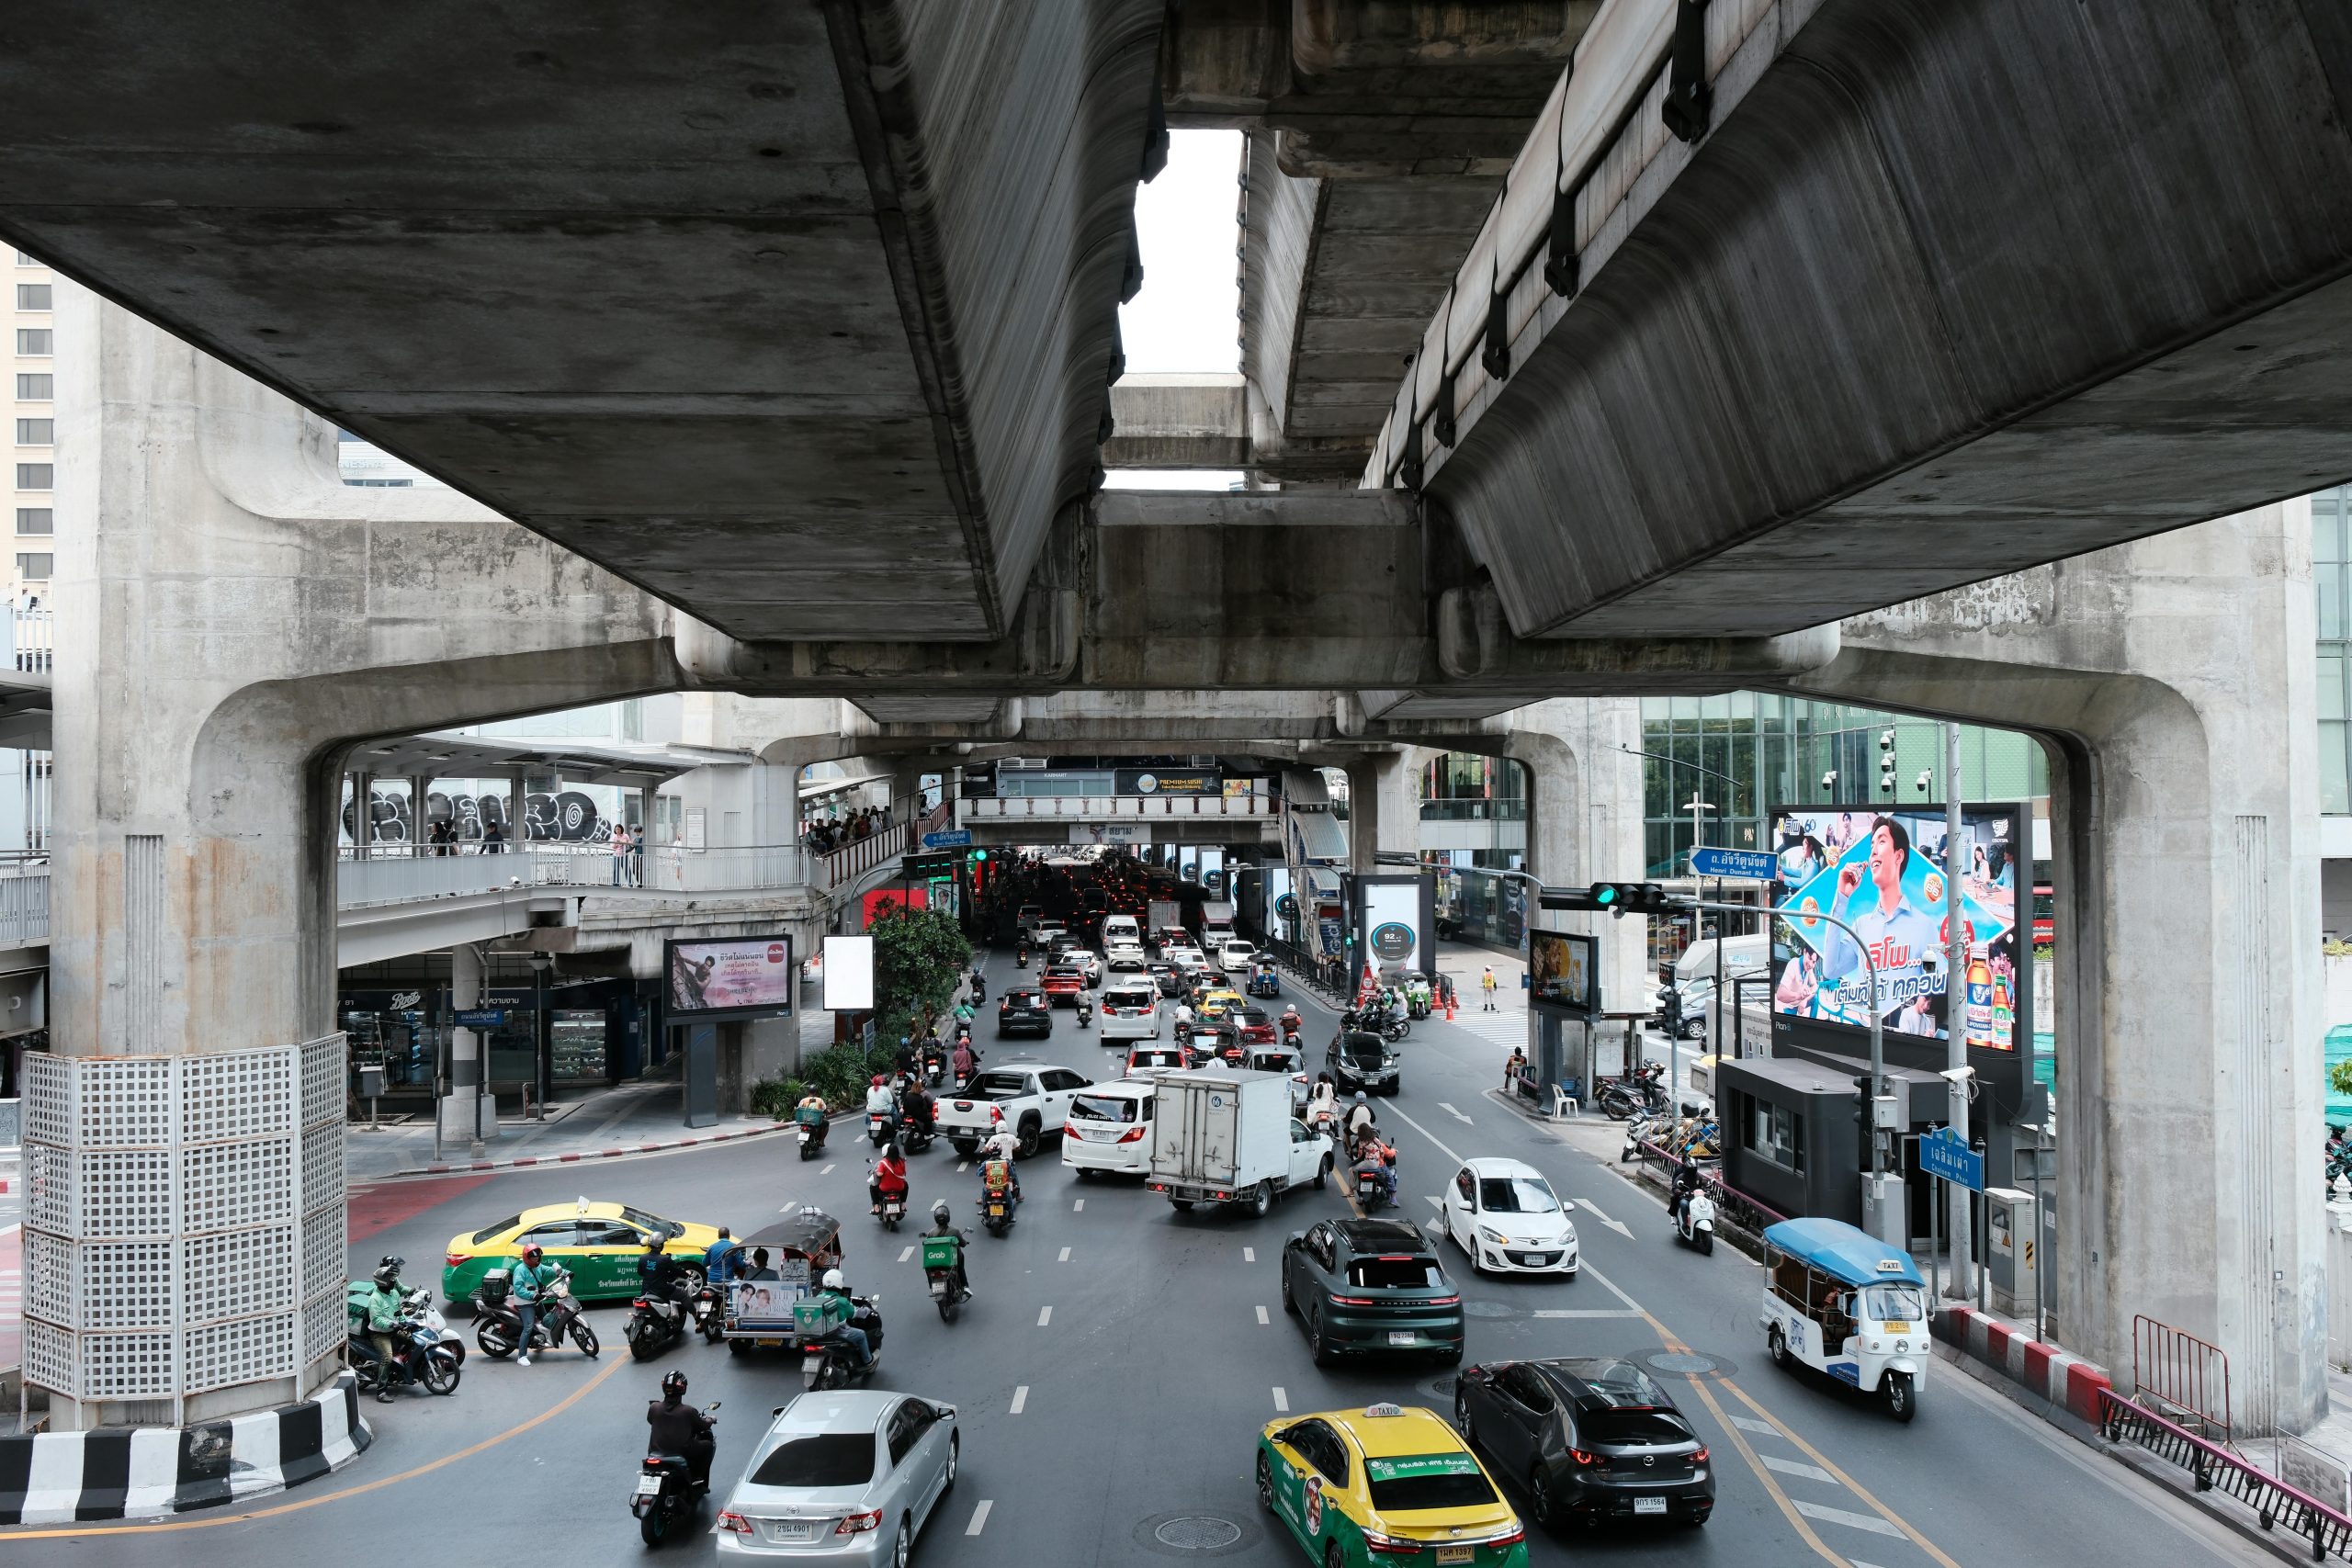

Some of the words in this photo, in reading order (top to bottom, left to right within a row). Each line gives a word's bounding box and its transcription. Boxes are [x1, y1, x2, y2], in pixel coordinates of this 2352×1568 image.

[1109, 827, 1131, 835] สยาม
[1711, 855, 1720, 863] ถ.
[1722, 852, 1769, 869] อังรีดูนังต์
[390, 991, 421, 1010] Boots
[1213, 1097, 1220, 1106] 66
[1931, 1146, 1968, 1172] เฉลิมเผ่า
[1955, 1173, 1968, 1185] Phao
[1455, 1547, 1471, 1555] 1397
